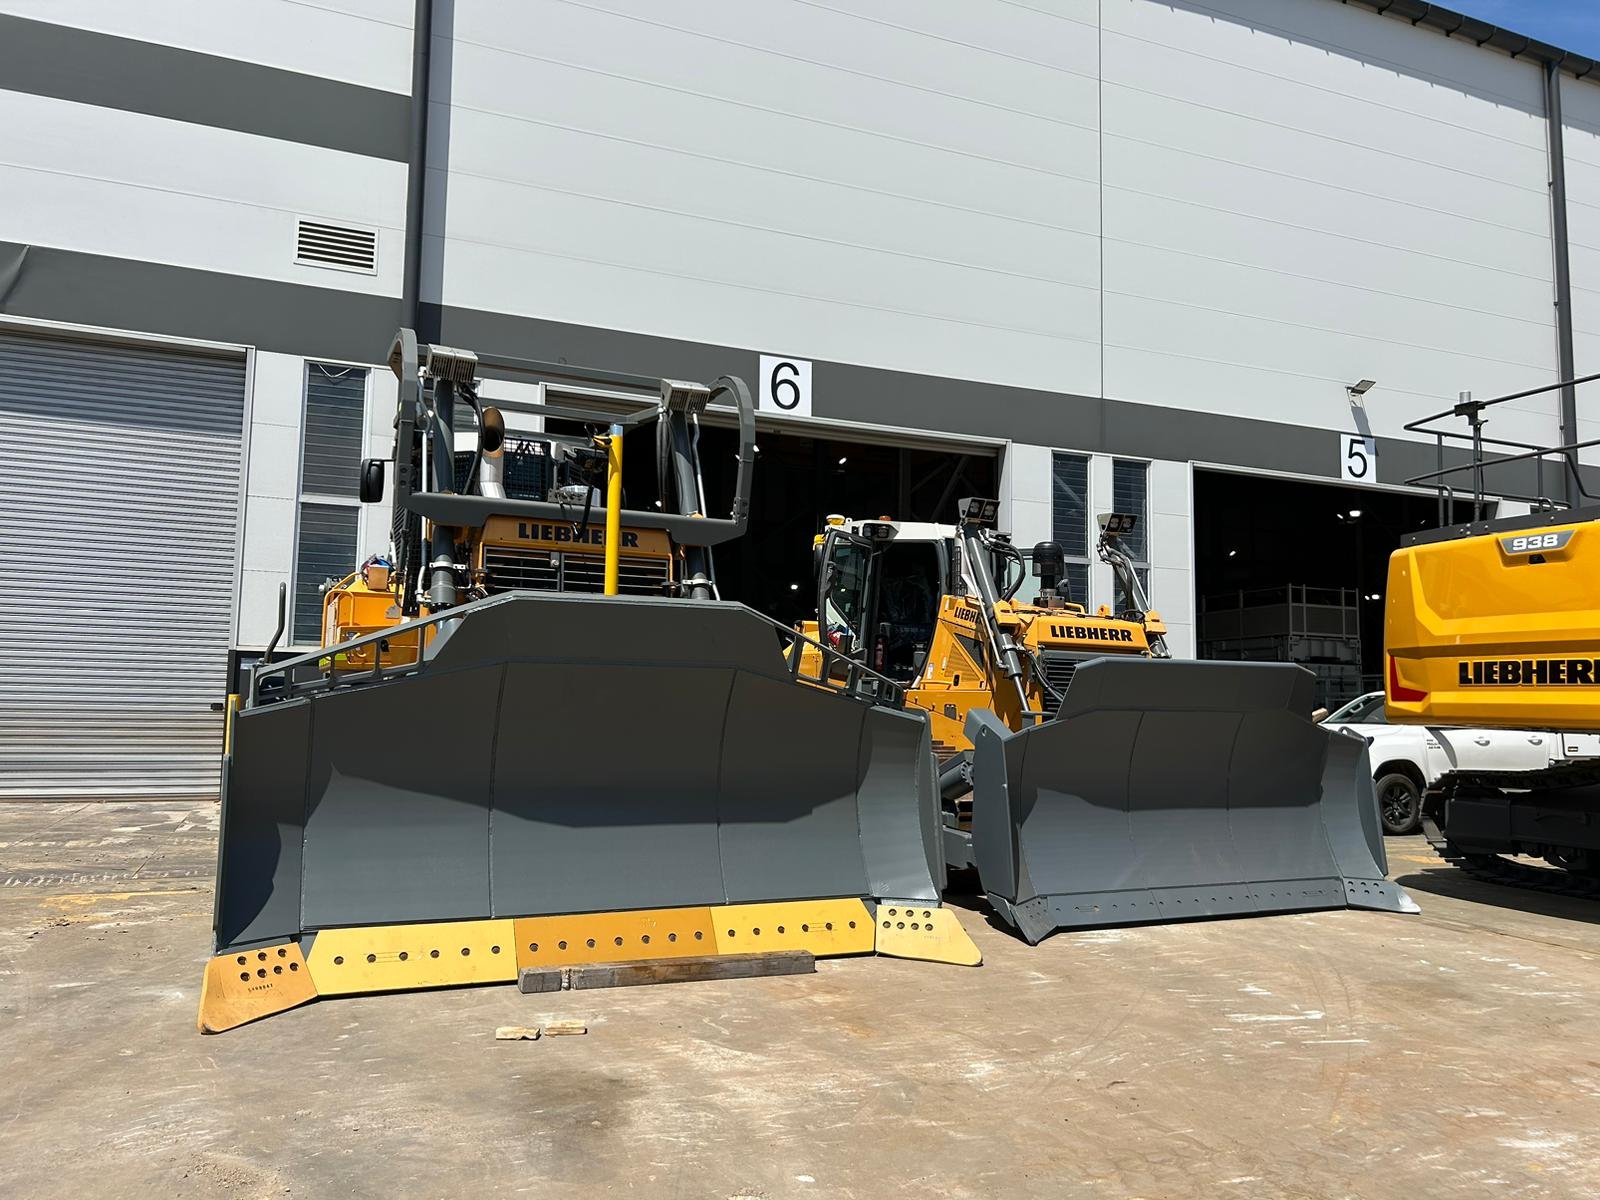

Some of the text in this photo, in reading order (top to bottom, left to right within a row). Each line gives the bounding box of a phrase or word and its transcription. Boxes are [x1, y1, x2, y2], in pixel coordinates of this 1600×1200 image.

[771, 362, 800, 410] 6
[1348, 438, 1367, 478] 5
[518, 522, 639, 548] LIEBHER
[1512, 533, 1558, 551] 938
[1050, 625, 1133, 642] LIEBHERR
[1458, 659, 1600, 685] LIEBHER
